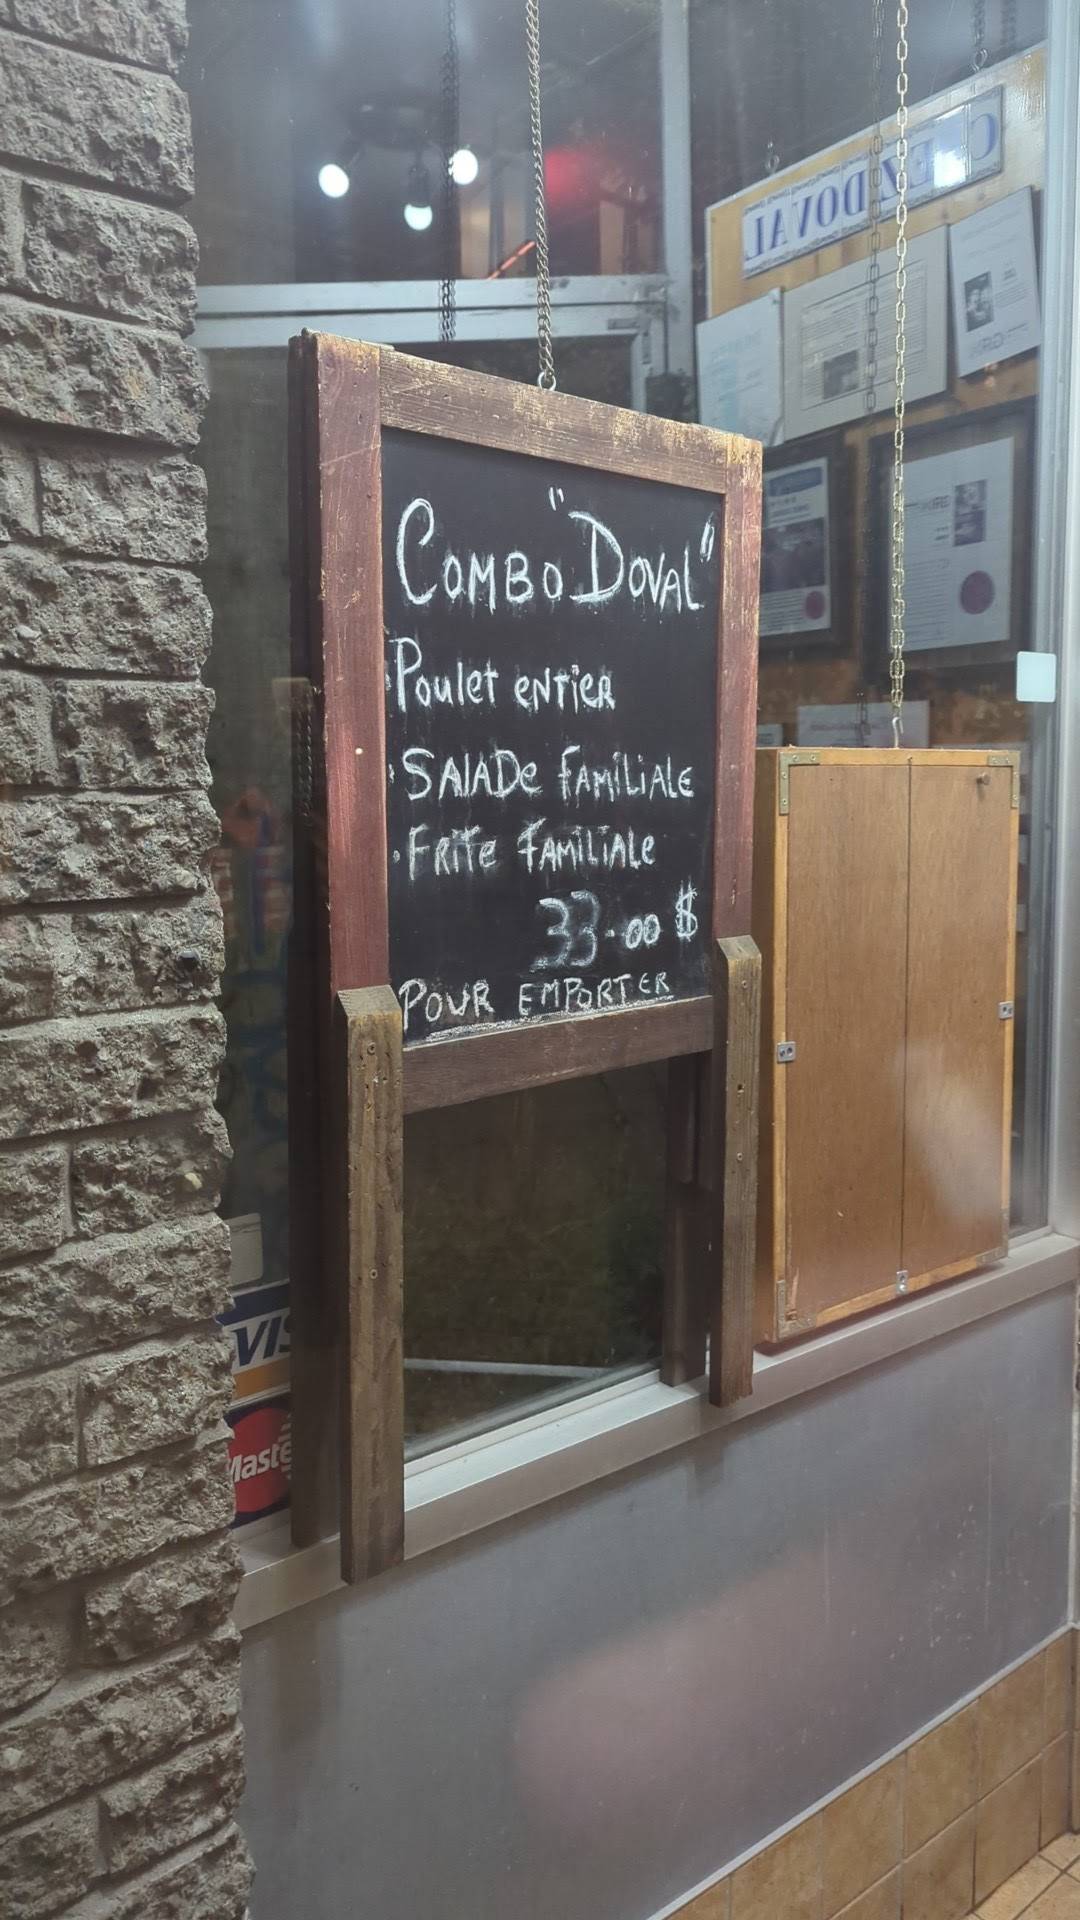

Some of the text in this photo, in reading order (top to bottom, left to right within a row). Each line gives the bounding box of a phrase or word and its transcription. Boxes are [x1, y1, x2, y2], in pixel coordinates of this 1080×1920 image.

[396, 498, 564, 615] COMBO
[389, 636, 499, 713] Poulet
[675, 876, 699, 943] $
[398, 971, 671, 1031] POUR EMPORTER
